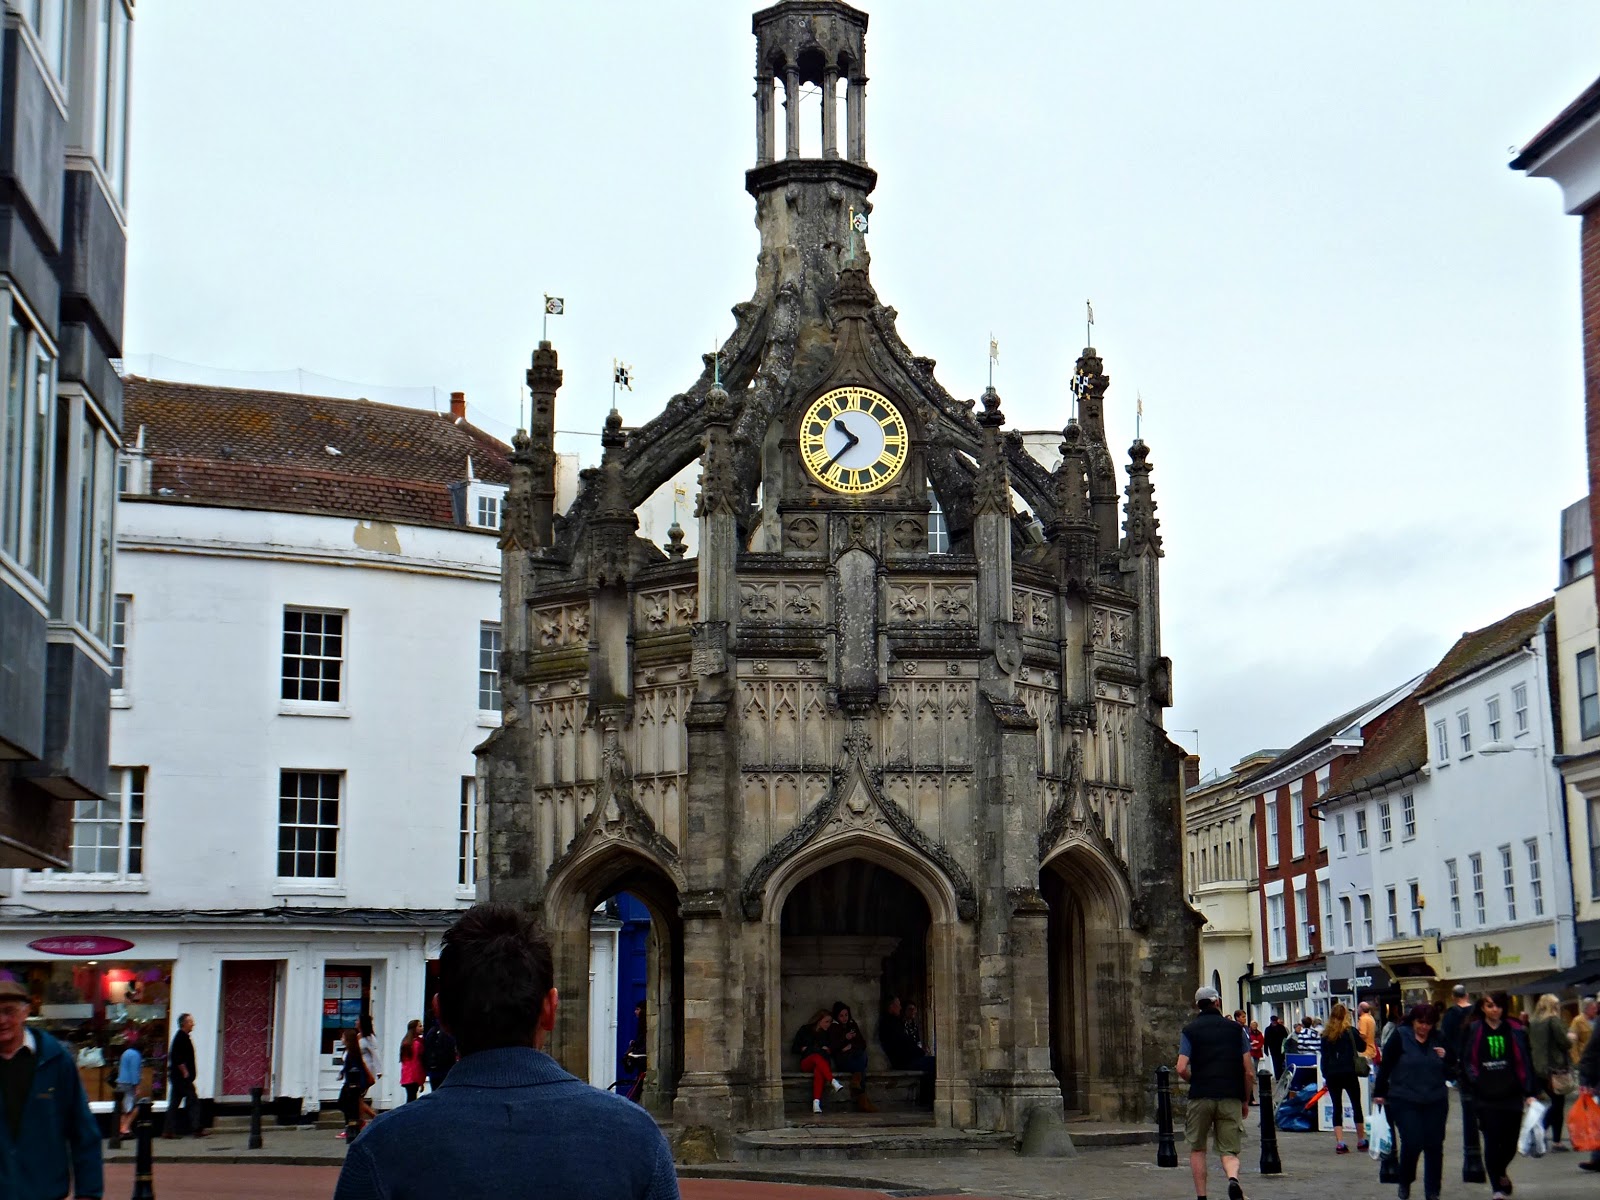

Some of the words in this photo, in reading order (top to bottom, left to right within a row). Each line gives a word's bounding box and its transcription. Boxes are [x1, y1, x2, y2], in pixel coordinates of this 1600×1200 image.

[826, 399, 841, 416] XI
[846, 395, 860, 409] XII
[867, 400, 878, 415] I
[812, 414, 828, 427] X
[879, 414, 896, 427] II
[808, 434, 823, 445] IX
[885, 435, 900, 445] III
[827, 463, 842, 481] VII
[849, 470, 860, 485] VI
[869, 465, 882, 481] V
[1264, 983, 1283, 994] MOUNTAIN
[1283, 981, 1306, 992] WAREHOUSE
